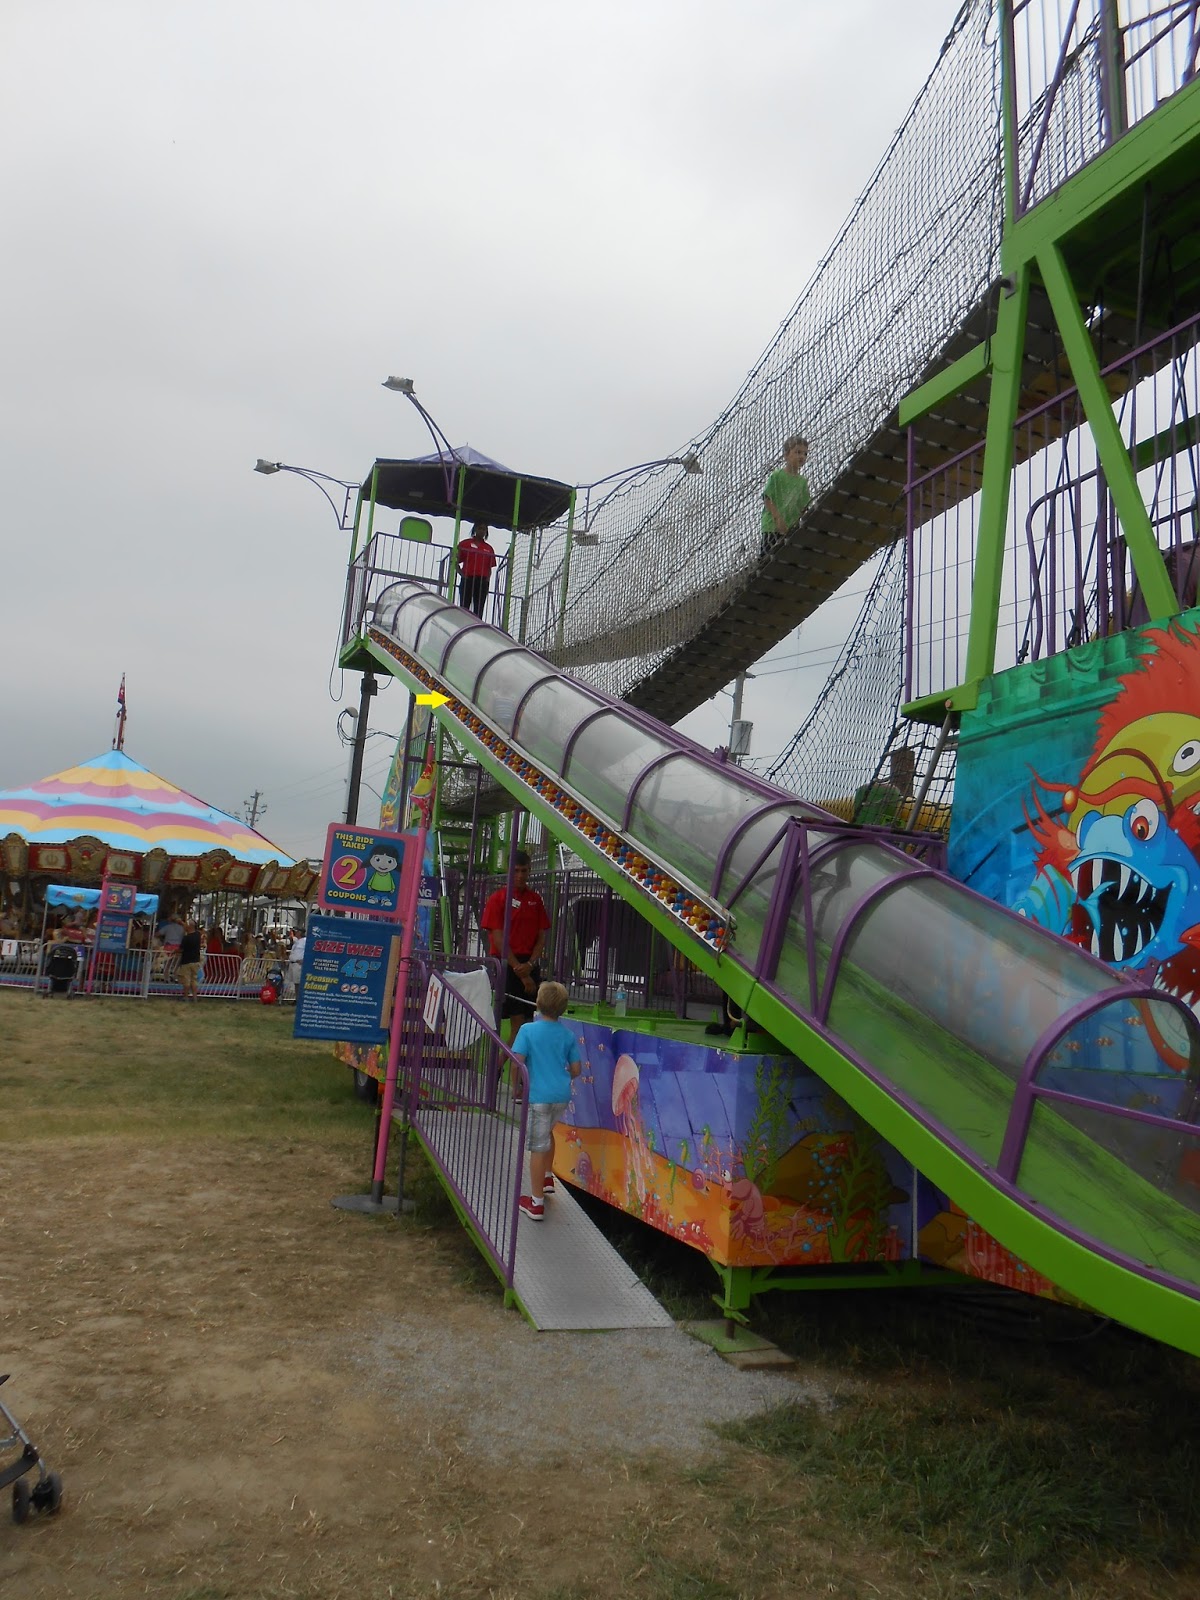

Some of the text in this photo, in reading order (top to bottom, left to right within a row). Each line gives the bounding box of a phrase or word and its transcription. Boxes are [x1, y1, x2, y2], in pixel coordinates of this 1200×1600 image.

[336, 832, 374, 844] THIS RIDE
[342, 840, 366, 850] TAKES
[338, 858, 358, 884] 2
[111, 894, 117, 902] 3
[328, 890, 366, 900] COUPONS
[312, 940, 384, 958] SIZE WIZE
[306, 974, 338, 984] Treasure
[304, 982, 328, 991] Island
[426, 982, 440, 1024] 11
